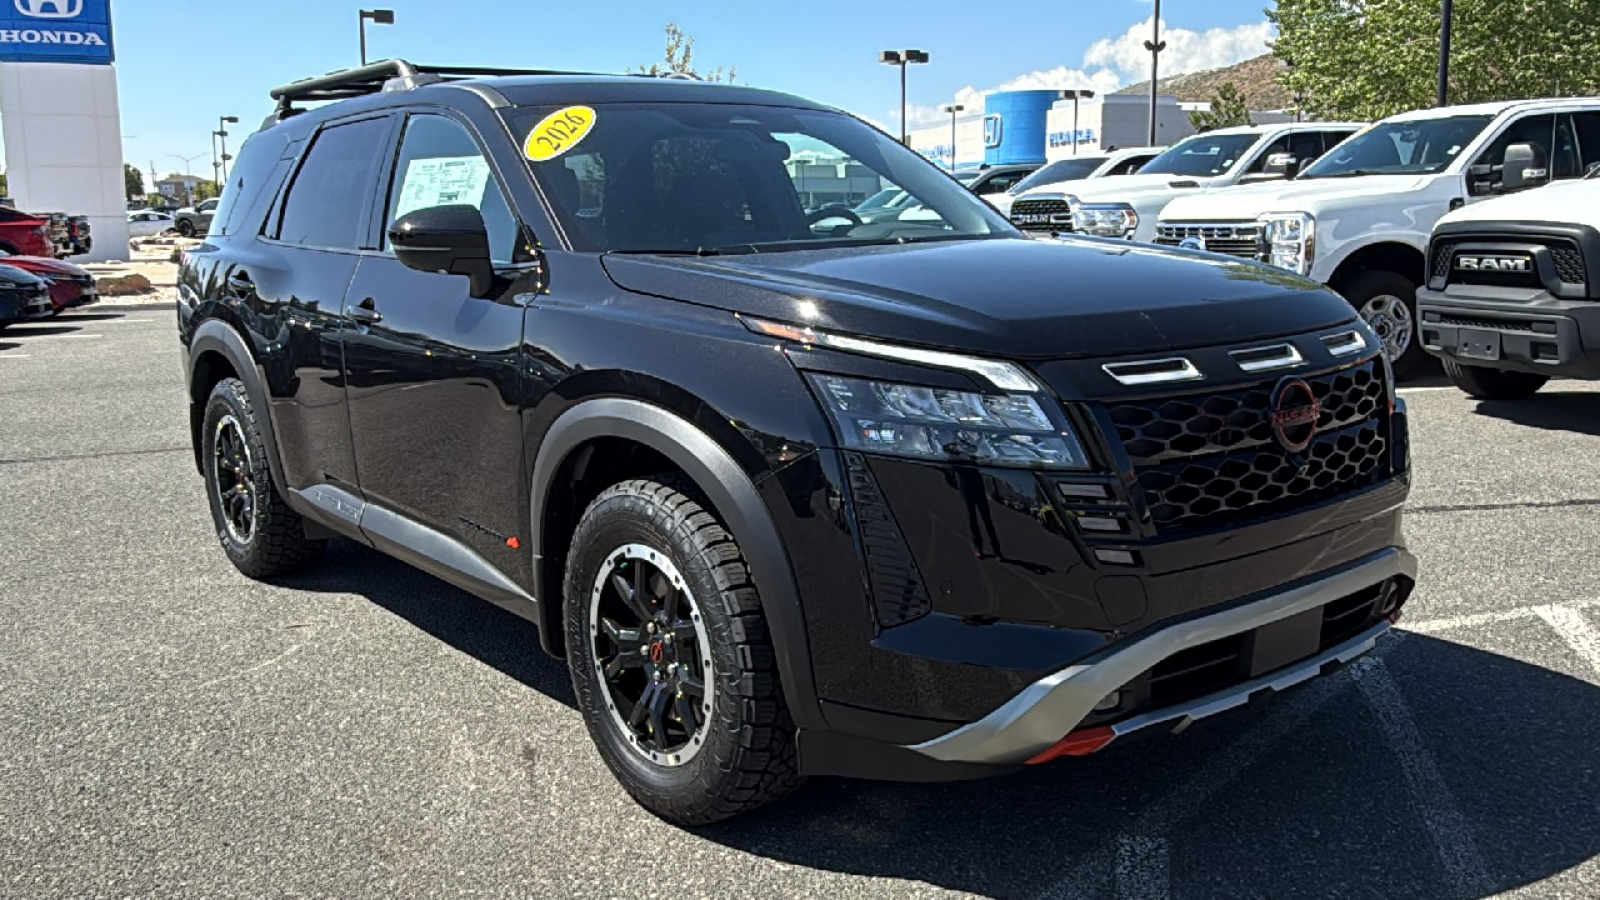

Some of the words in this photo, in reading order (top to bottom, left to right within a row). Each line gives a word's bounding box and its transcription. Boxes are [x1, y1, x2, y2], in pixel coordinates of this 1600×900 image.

[0, 29, 107, 45] HONDA
[536, 111, 585, 151] 2026
[1460, 257, 1525, 270] RAM
